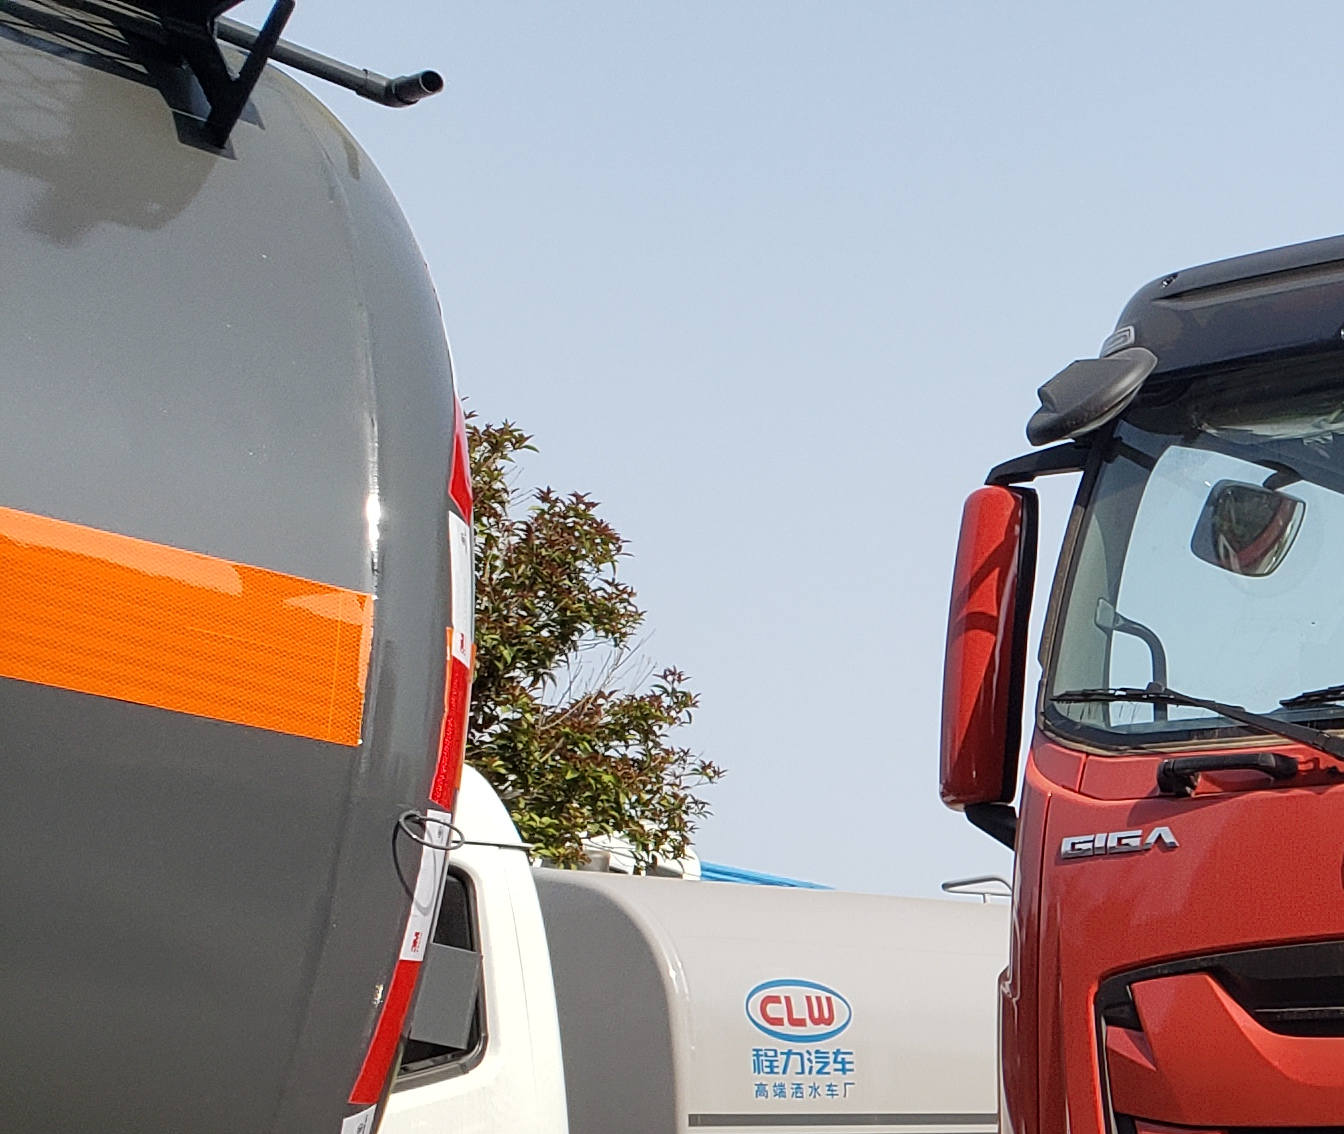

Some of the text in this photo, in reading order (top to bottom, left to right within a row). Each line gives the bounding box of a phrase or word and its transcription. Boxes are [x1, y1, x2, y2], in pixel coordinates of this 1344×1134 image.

[1061, 826, 1179, 859] GIGA
[759, 995, 835, 1027] CLW
[751, 1048, 855, 1075] 程力汽车
[754, 1082, 856, 1099] 高端洒水车厂
